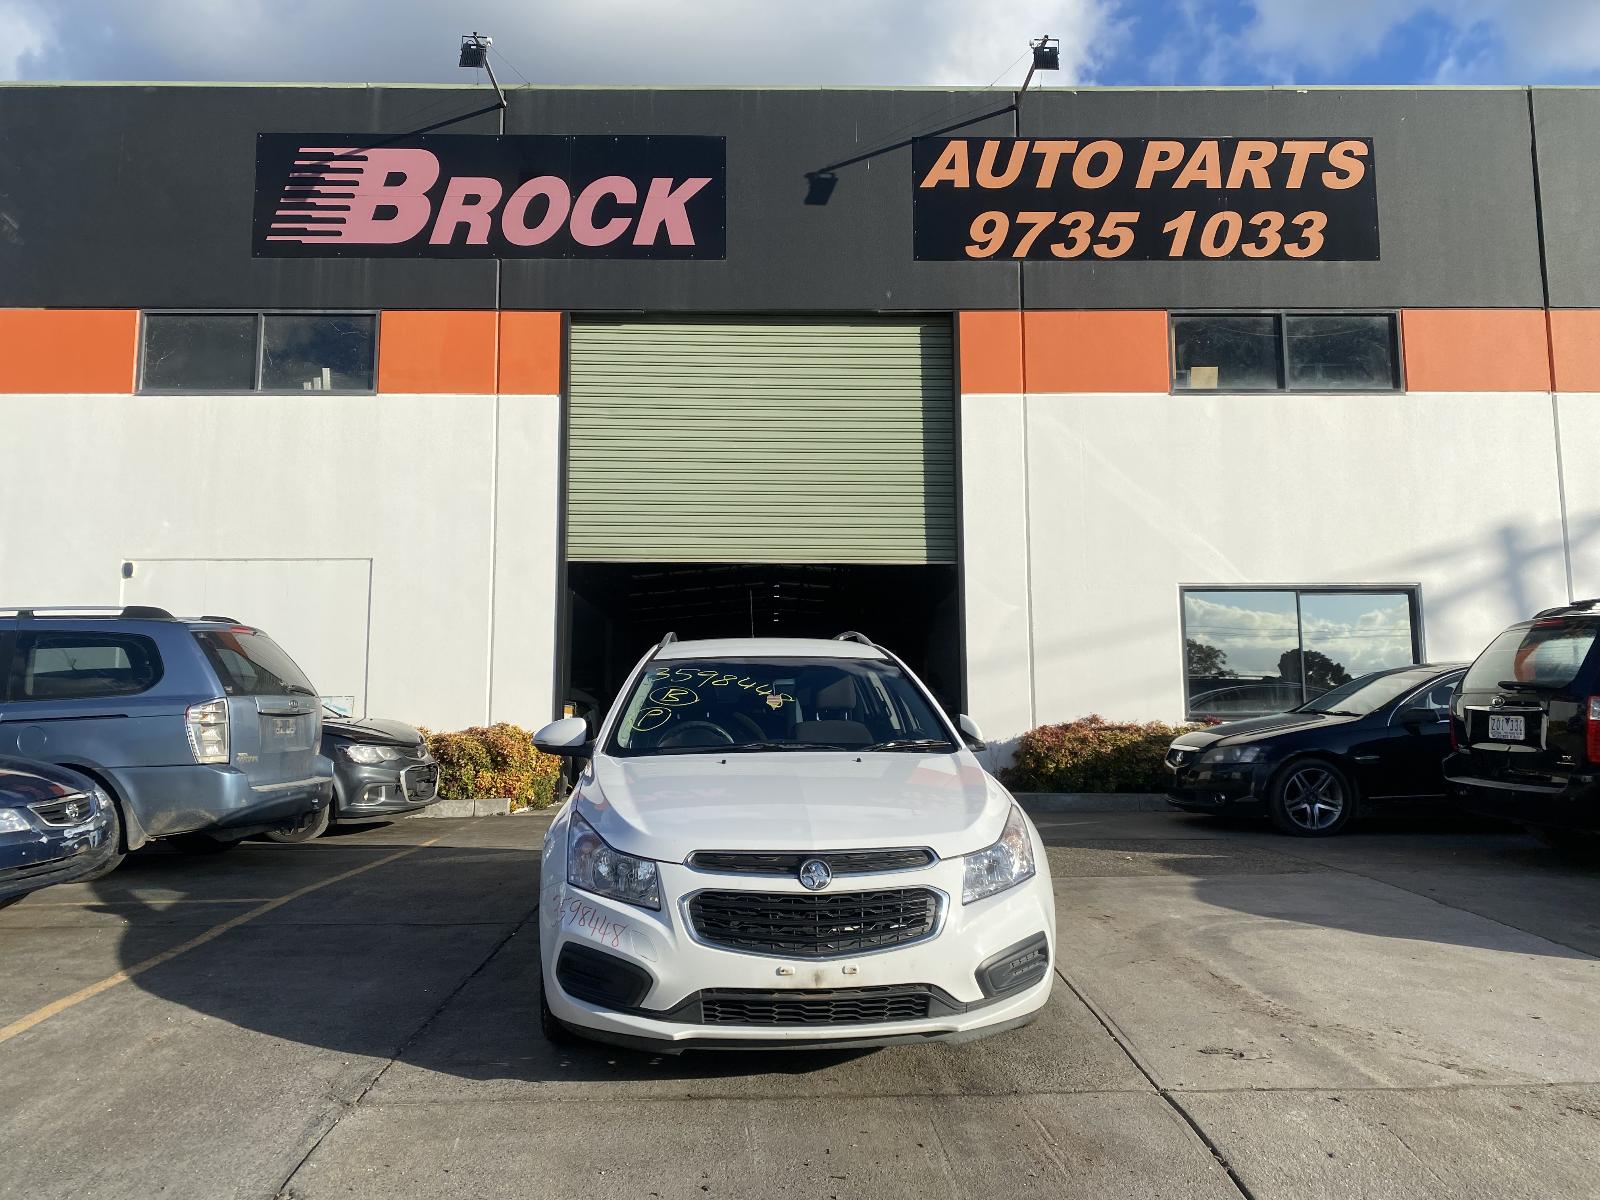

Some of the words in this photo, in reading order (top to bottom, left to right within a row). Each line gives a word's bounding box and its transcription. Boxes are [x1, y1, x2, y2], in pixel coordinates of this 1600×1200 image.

[920, 140, 1124, 189] AUTO
[1135, 140, 1369, 190] PARTS
[266, 147, 713, 246] BROCK
[965, 211, 1141, 259] 9735
[1162, 210, 1328, 258] 1033
